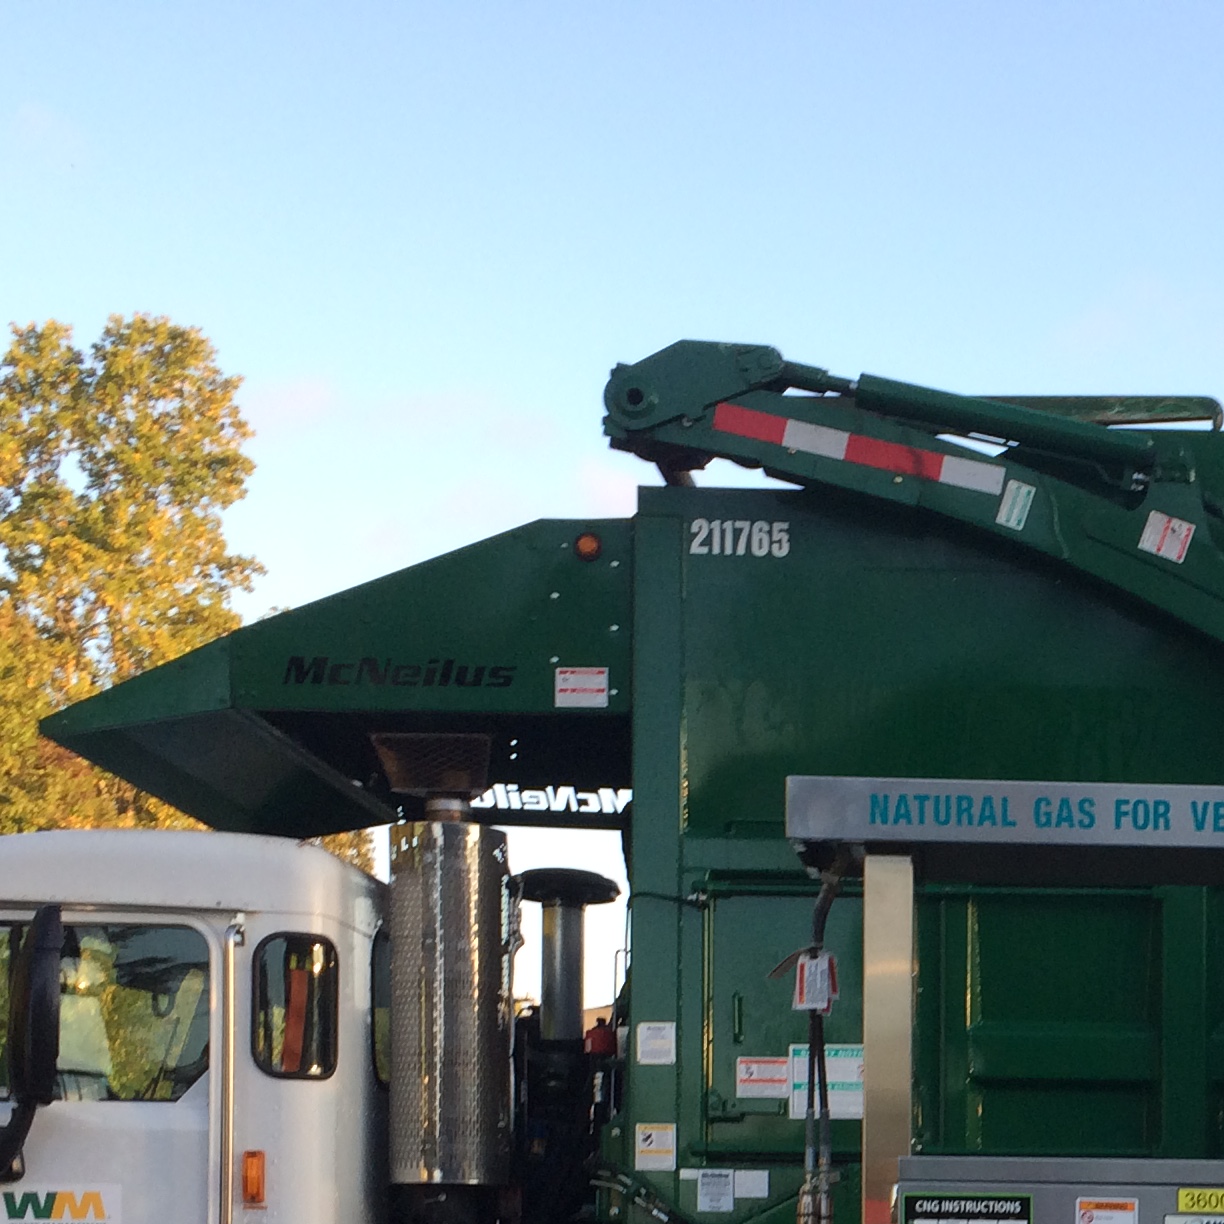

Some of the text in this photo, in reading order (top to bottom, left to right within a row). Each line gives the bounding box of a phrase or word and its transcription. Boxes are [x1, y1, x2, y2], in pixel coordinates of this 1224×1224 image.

[689, 518, 791, 558] 211765
[282, 656, 518, 688] McNeilus
[869, 793, 1017, 828] NATURAL
[1034, 797, 1096, 830] GAS
[1114, 799, 1171, 831] FOR
[3, 1191, 106, 1220] WM
[915, 1200, 1022, 1214] CNG INSTRUCTIONS
